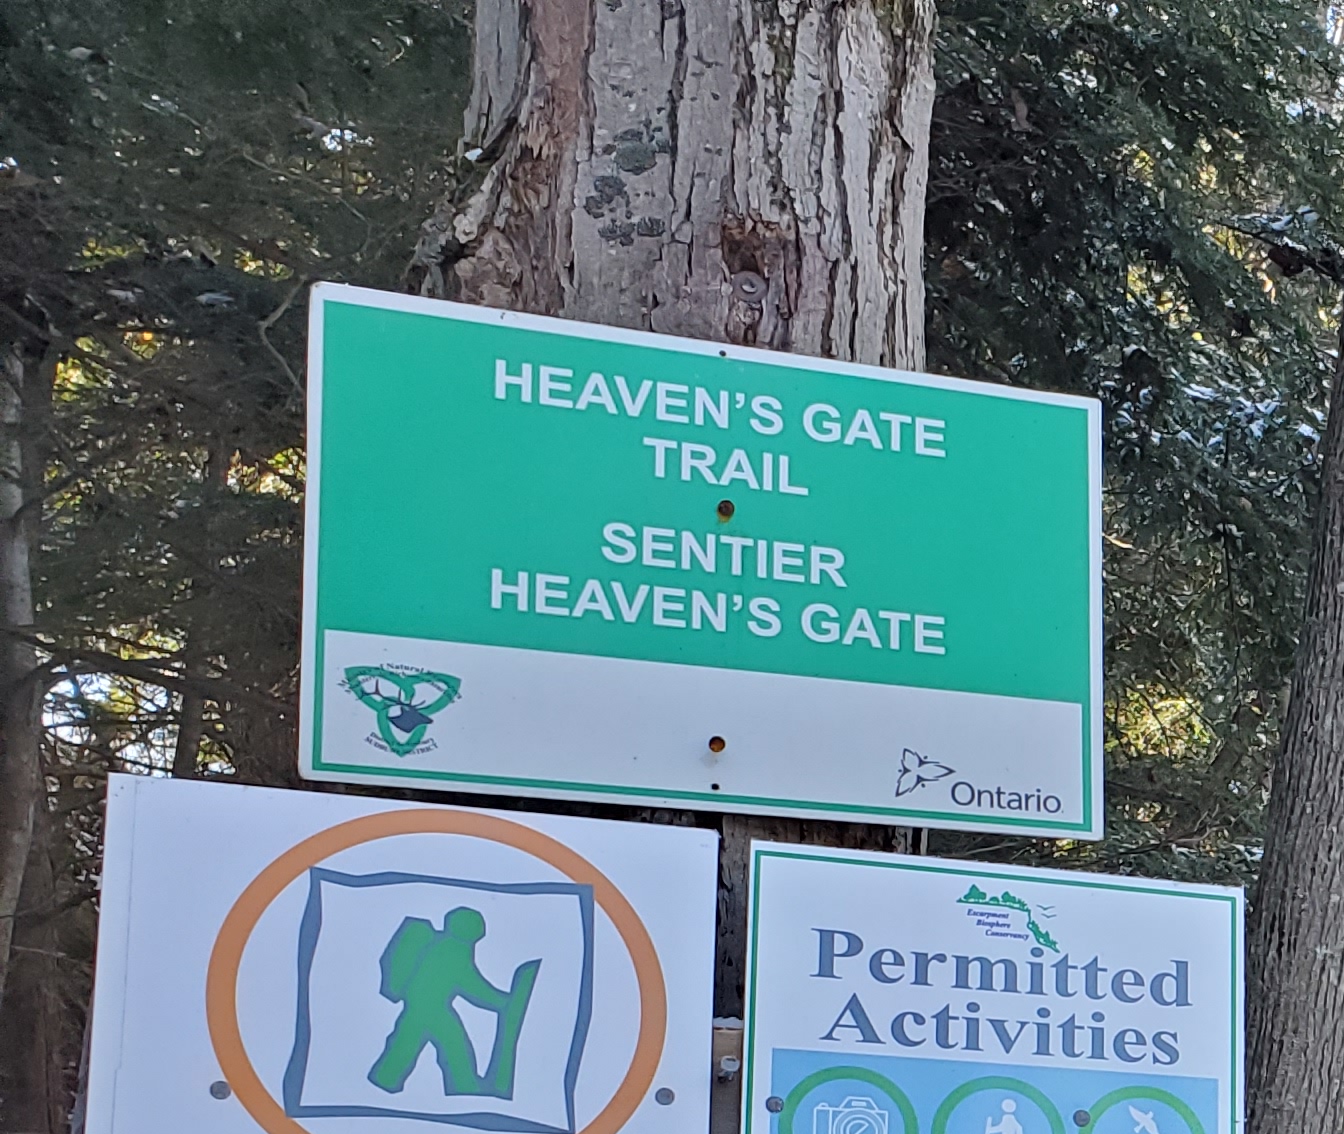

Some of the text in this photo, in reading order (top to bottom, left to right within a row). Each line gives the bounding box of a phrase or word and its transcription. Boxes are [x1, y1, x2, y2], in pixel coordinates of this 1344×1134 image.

[802, 402, 947, 458] GATE
[643, 437, 808, 496] TRAIL
[601, 523, 846, 587] SENTIER
[801, 603, 946, 656] GATE
[951, 782, 1062, 813] Ontario
[809, 928, 1192, 1008] Permitted
[819, 993, 1180, 1065] Activities
